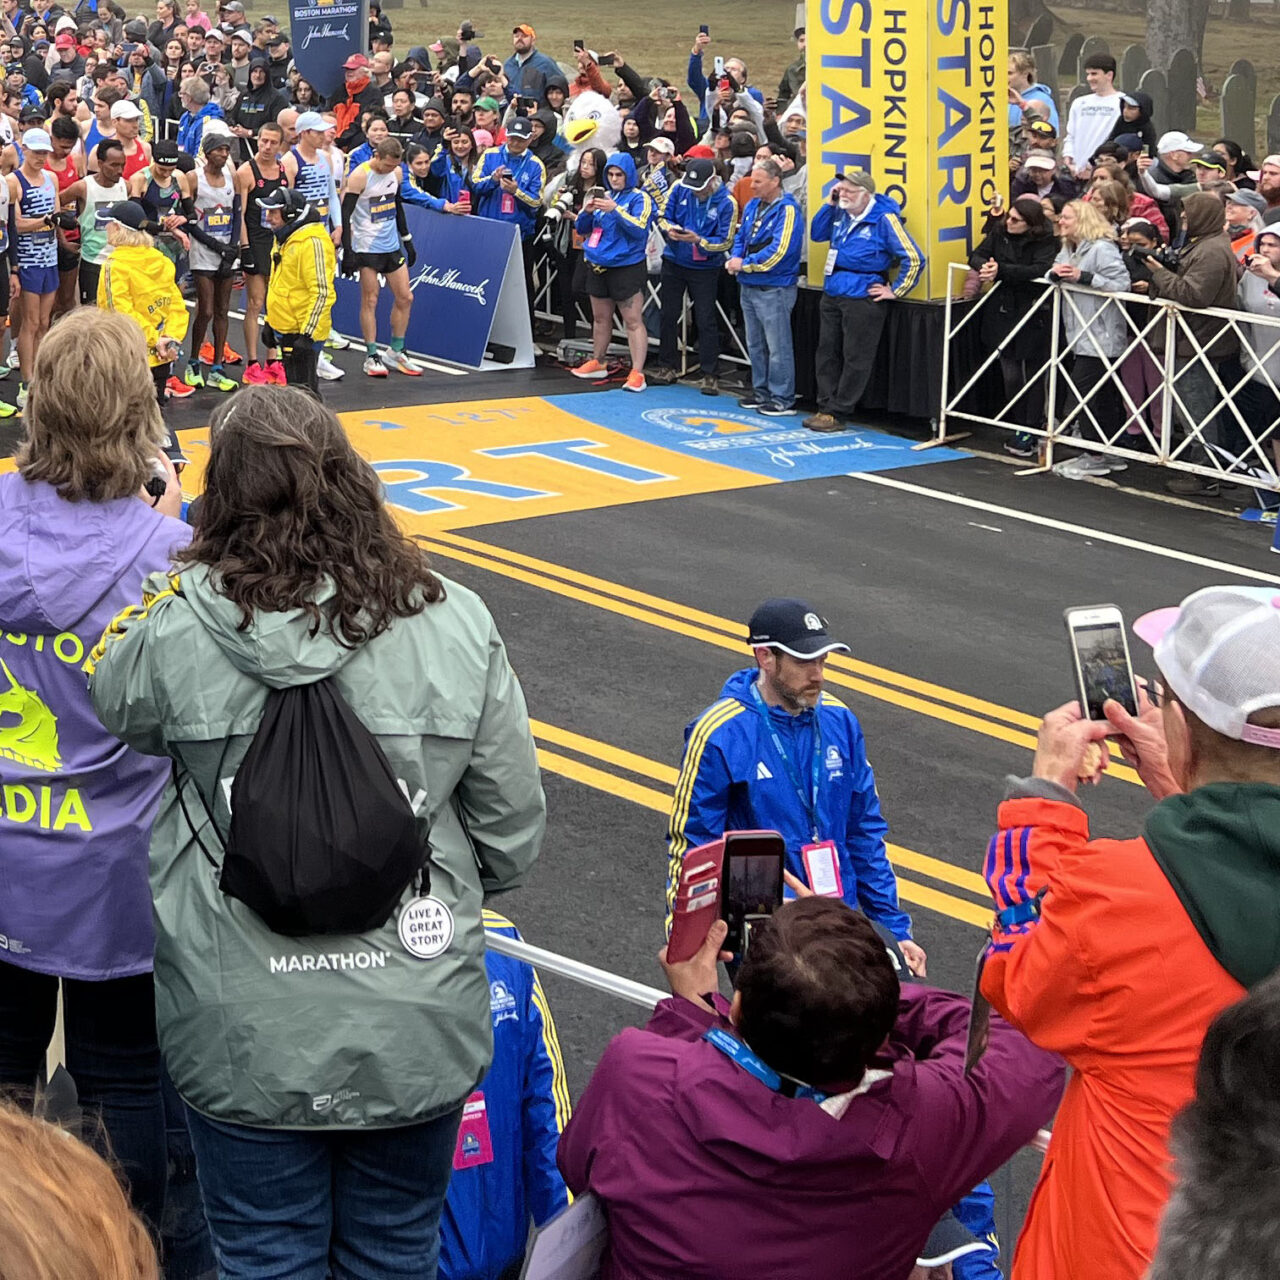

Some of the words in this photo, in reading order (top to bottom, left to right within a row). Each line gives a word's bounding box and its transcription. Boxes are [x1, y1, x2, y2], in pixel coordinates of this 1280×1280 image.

[294, 8, 321, 18] BOSTON
[321, 5, 358, 16] MARATHON
[883, 9, 907, 225] HOPKINTO
[978, 5, 996, 234] HOPKINTO
[409, 263, 442, 292] John
[440, 267, 489, 306] Hancock
[408, 908, 432, 920] LIVE
[435, 907, 442, 918] A
[409, 920, 443, 933] GREAT
[410, 933, 444, 946] STORY
[269, 952, 387, 974] MARATHON
